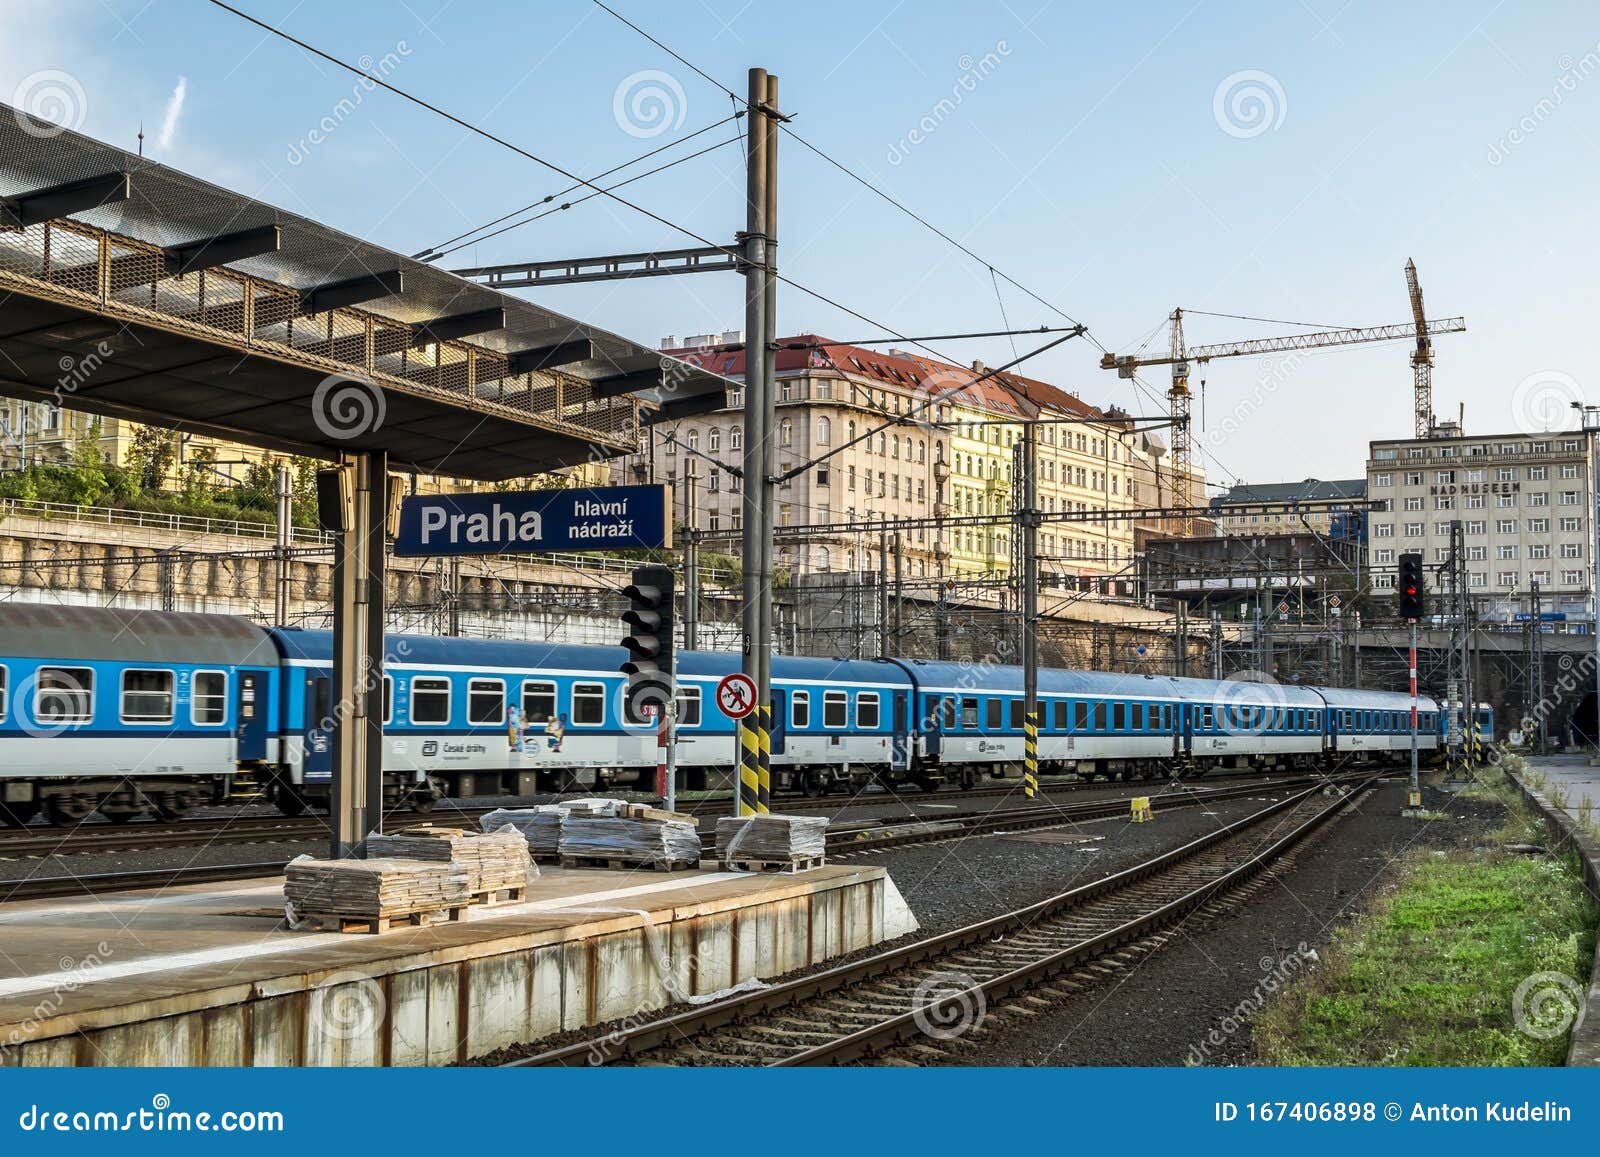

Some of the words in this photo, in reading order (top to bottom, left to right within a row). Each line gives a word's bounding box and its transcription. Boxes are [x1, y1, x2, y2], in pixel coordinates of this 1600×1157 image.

[1430, 485, 1457, 496] NAD
[574, 497, 630, 517] hlavní
[420, 504, 543, 545] Praha
[568, 519, 634, 539] nádraží
